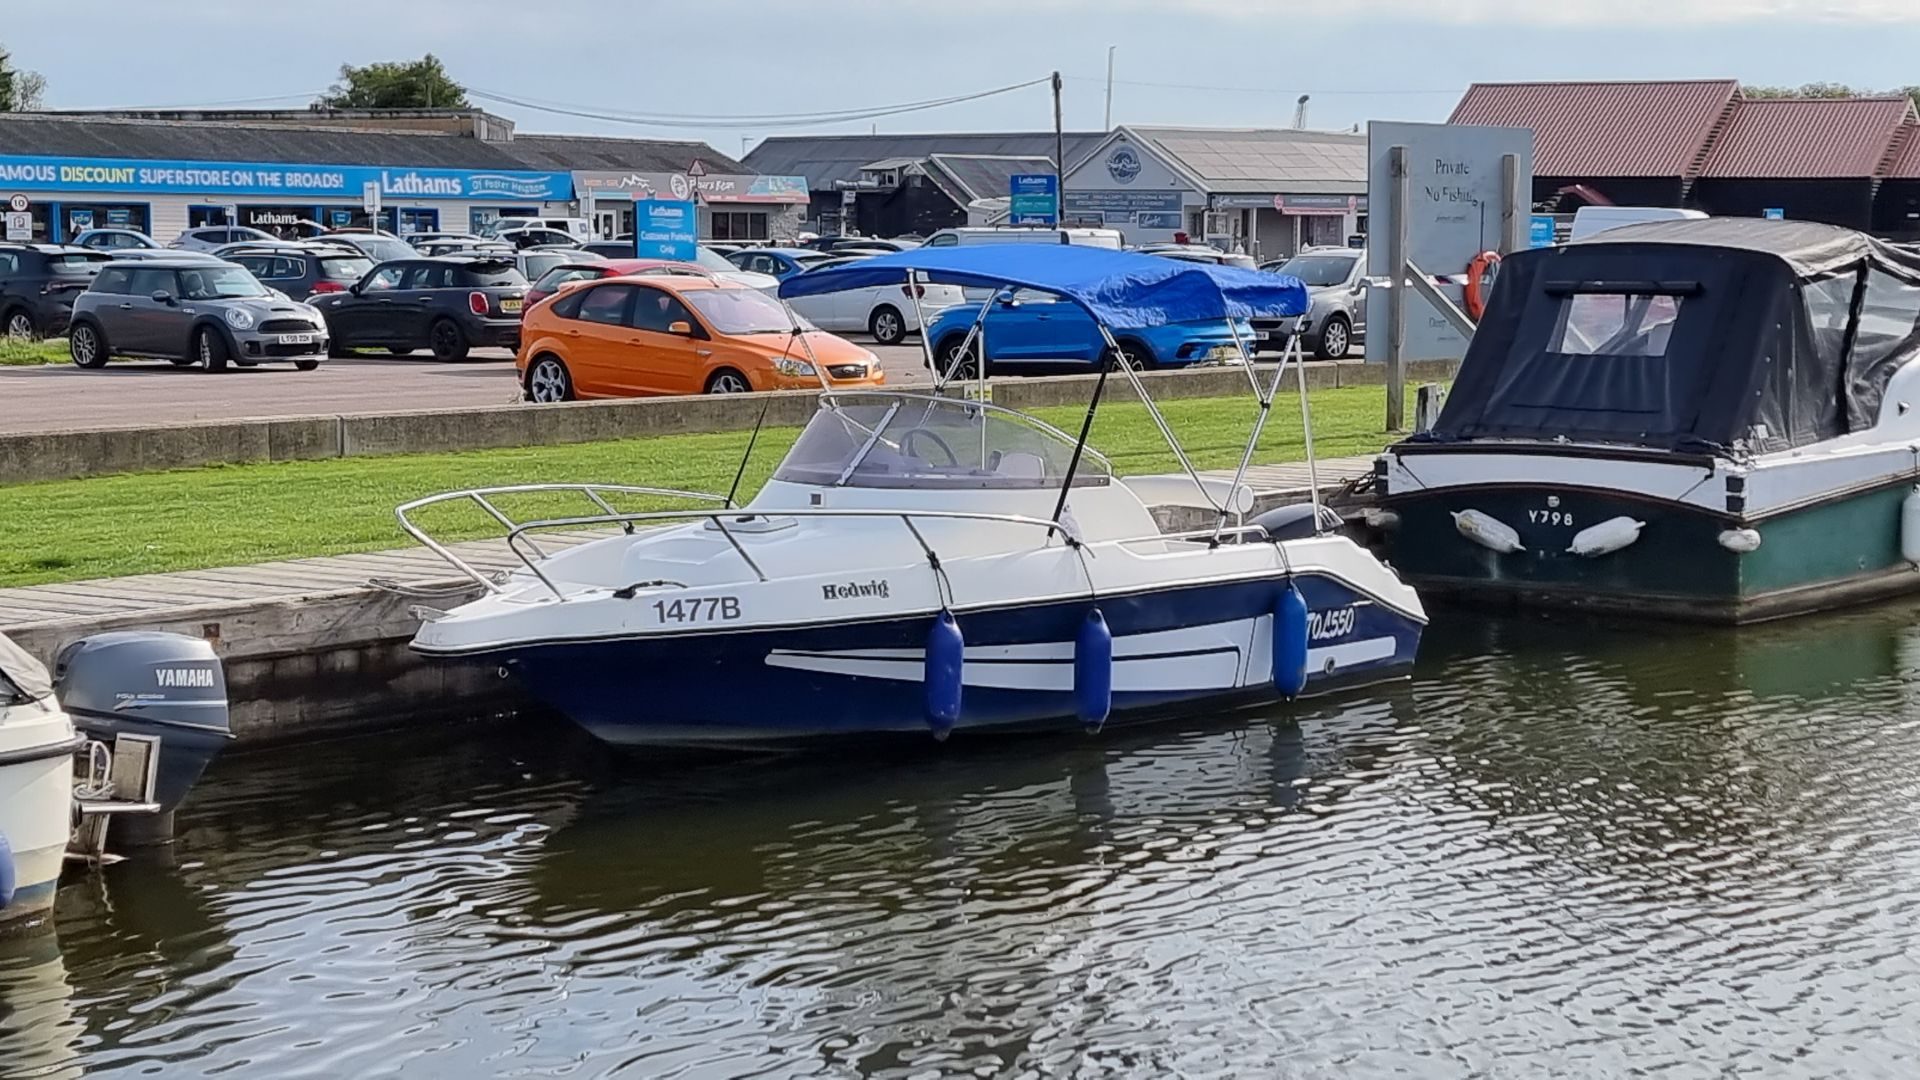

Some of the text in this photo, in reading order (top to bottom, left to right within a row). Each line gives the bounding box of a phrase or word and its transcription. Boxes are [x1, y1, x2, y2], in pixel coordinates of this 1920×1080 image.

[1435, 159, 1470, 175] Private
[60, 166, 136, 183] DISCOUNT
[139, 168, 230, 186] SUPERSTORE
[231, 171, 253, 186] ON
[256, 172, 281, 187] THE
[285, 173, 344, 188] BROADS!
[381, 171, 463, 195] Lathams
[14, 199, 25, 207] 10
[250, 211, 298, 225] Lathams
[1528, 509, 1573, 526] Y798
[821, 579, 889, 601] Hedwig
[652, 596, 741, 625] 1477B
[156, 669, 214, 687] YAMAHA
